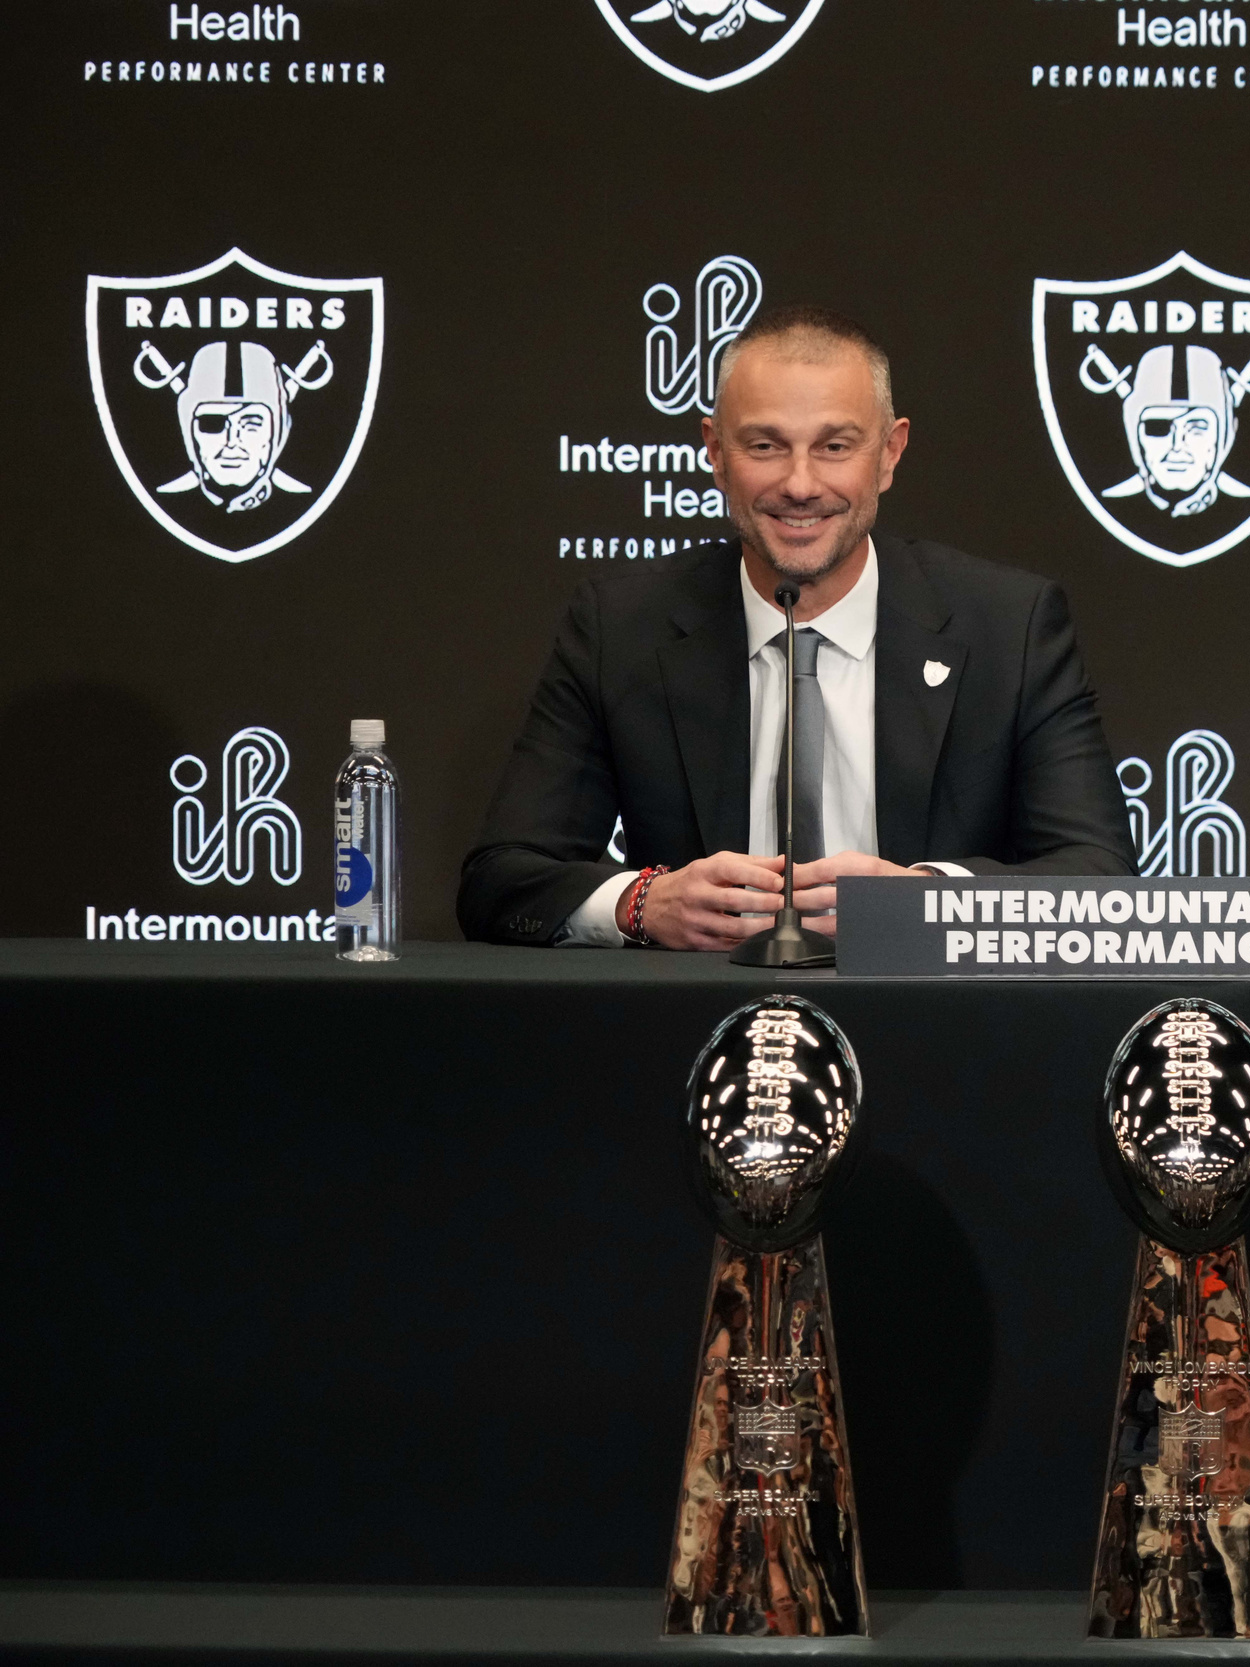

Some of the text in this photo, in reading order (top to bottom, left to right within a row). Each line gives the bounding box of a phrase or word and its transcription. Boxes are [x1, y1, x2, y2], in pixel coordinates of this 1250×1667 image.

[171, 4, 300, 42] Health
[1118, 8, 1247, 47] Health
[84, 60, 386, 84] PERFORMANCE CENTER
[1032, 65, 1218, 88] PERFORMANCE
[126, 297, 347, 330] RAIDERS
[352, 800, 365, 839] water
[334, 797, 352, 893] smart
[1130, 1361, 1250, 1374] VINCE LOMBARDI
[1163, 1378, 1220, 1392] TROPHY
[737, 1507, 758, 1517] AFC
[1134, 1495, 1180, 1507] SUPER
[1185, 1495, 1225, 1507] BOWL
[1160, 1512, 1181, 1521] AFC
[1198, 1512, 1220, 1521] NFC
